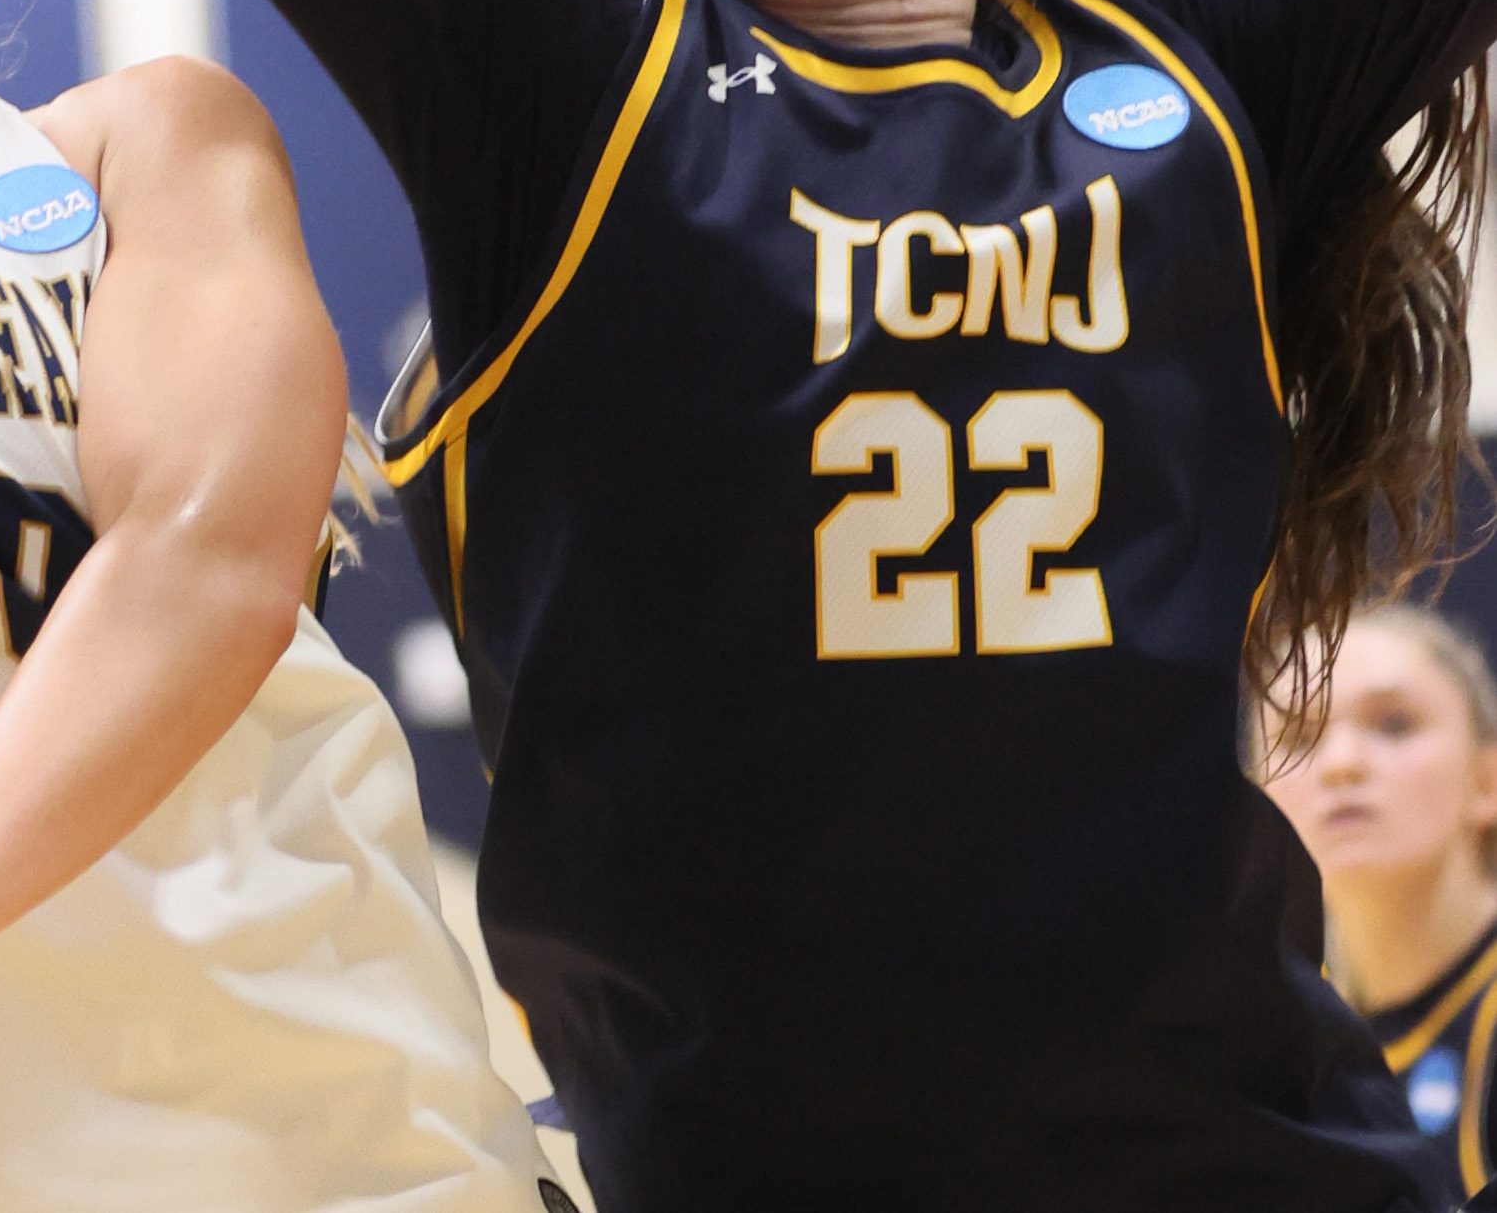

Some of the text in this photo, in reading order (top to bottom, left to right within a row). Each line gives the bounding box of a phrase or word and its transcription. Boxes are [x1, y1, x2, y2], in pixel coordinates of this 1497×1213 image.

[1087, 92, 1185, 136] NCAA
[790, 173, 1130, 366] TCNJ
[810, 388, 1113, 661] 22
